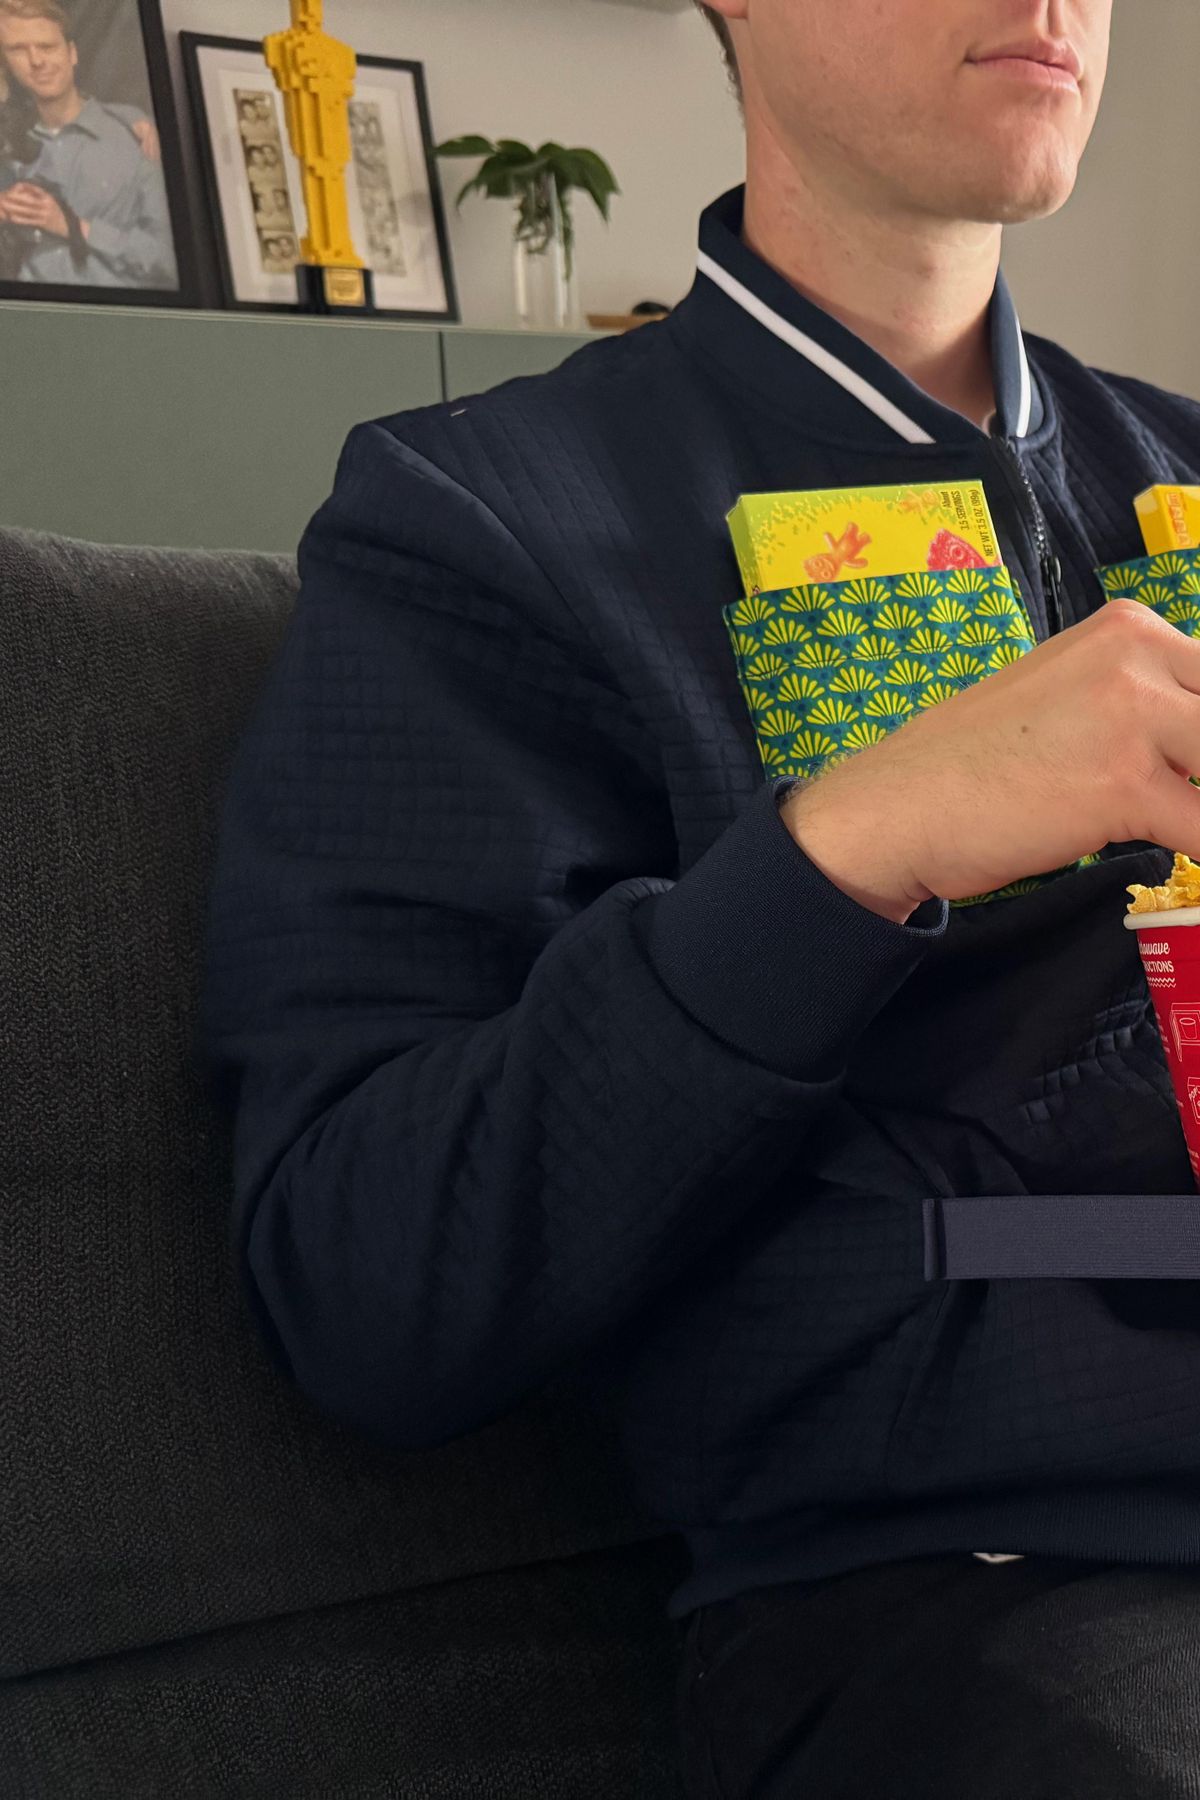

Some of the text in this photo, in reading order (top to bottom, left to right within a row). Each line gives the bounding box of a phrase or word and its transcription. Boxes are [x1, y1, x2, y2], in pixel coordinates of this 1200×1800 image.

[951, 491, 967, 519] SERVINGS
[974, 508, 983, 517] OZ
[979, 531, 989, 543] WT
[983, 544, 993, 557] NET
